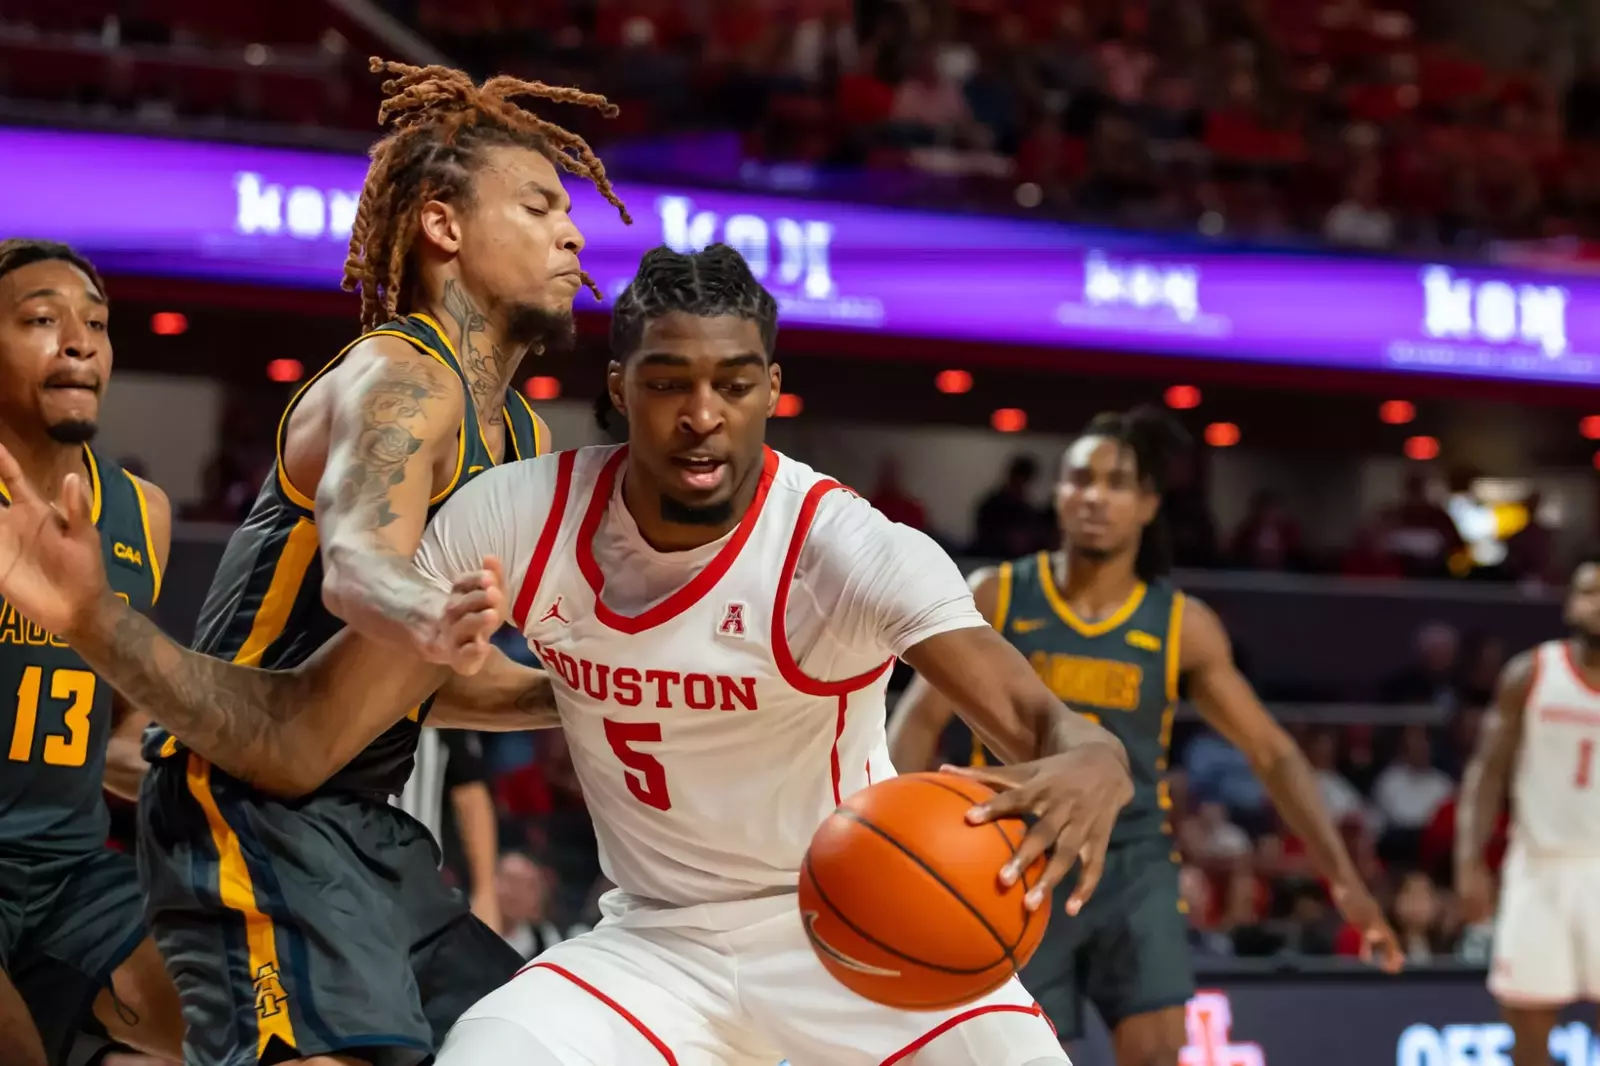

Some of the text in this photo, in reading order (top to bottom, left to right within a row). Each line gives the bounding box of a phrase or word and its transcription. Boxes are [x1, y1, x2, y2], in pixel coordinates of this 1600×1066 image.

[113, 541, 143, 567] CAA
[8, 665, 96, 767] 13
[533, 639, 758, 711] HOUSTON
[603, 717, 672, 812] 5
